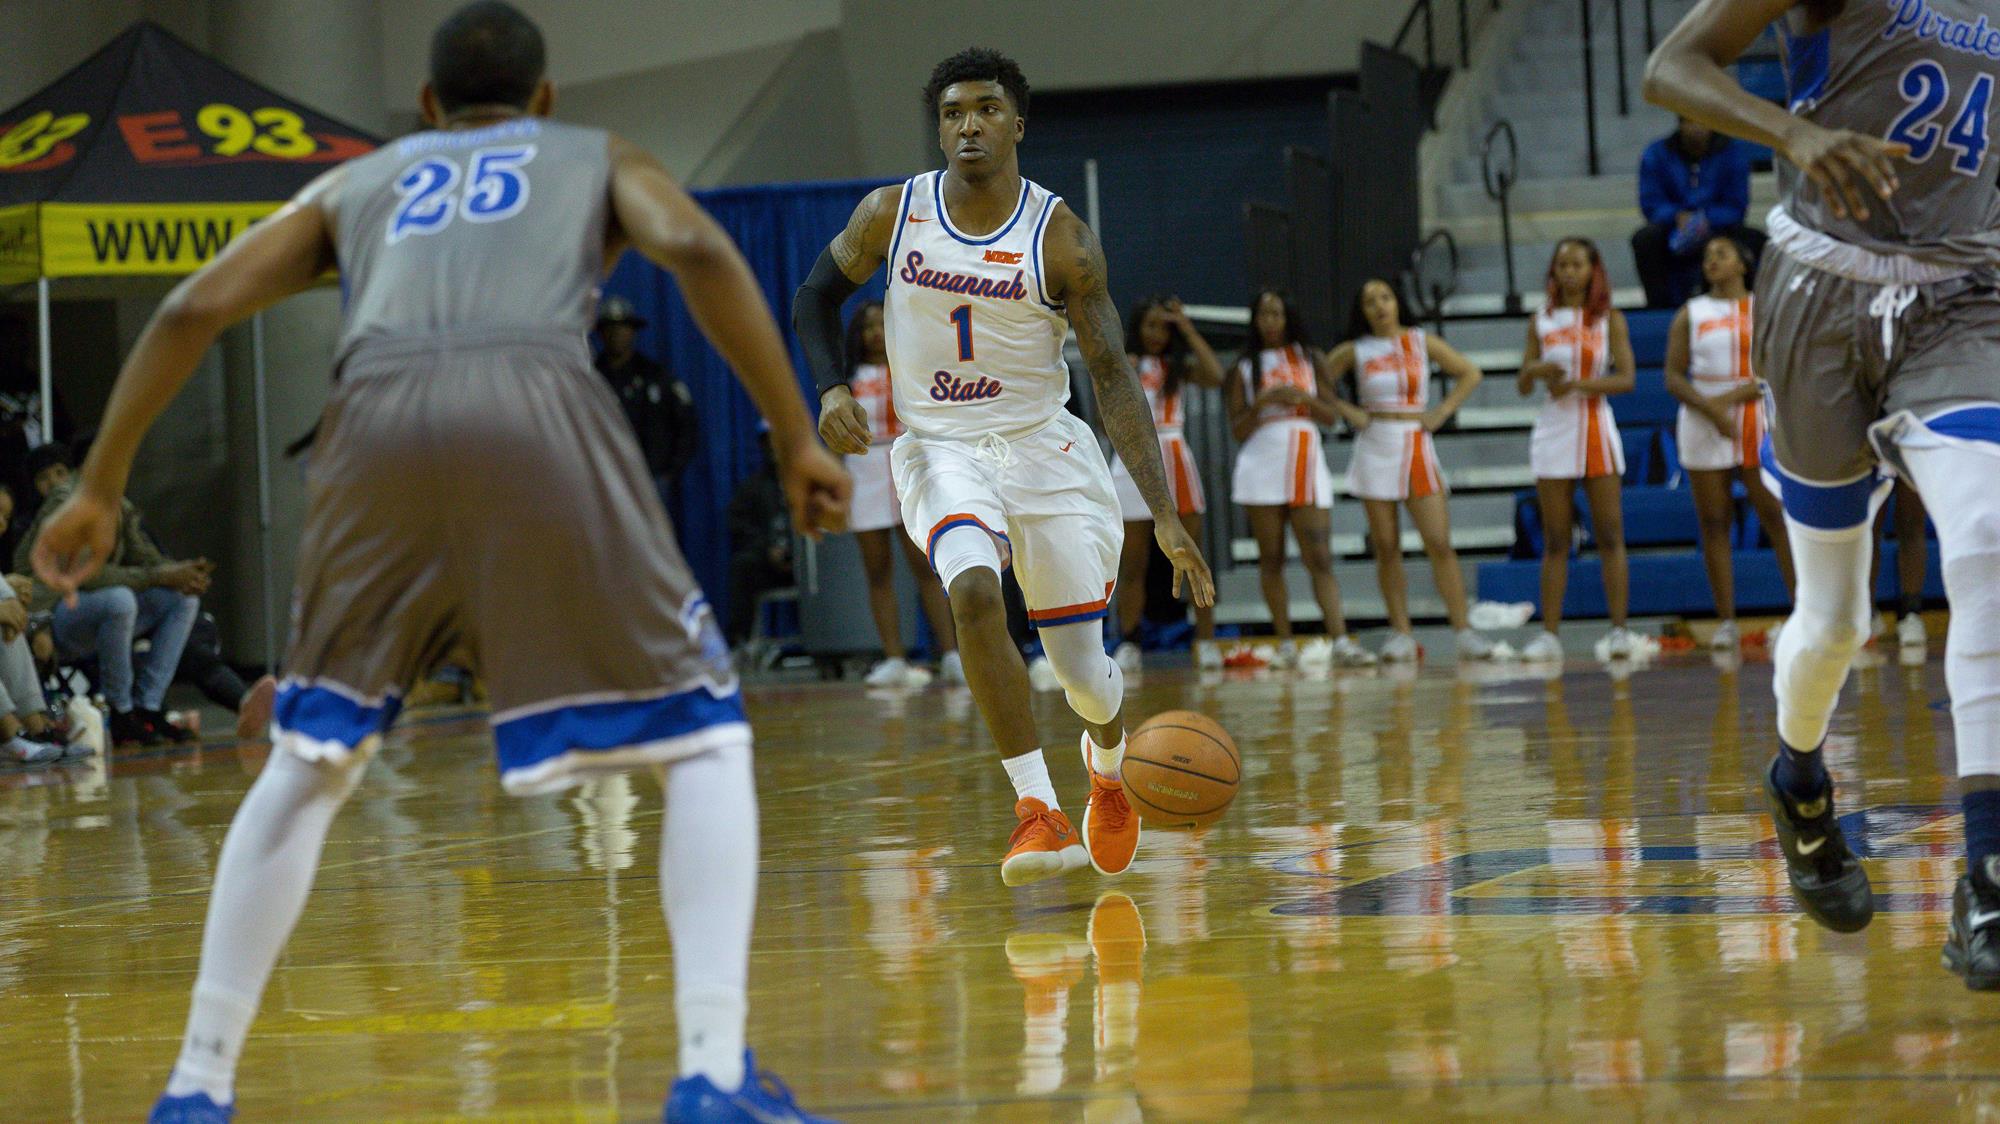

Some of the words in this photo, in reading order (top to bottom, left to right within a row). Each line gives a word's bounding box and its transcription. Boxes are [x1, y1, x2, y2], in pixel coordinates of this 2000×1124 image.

[1884, 58, 1994, 177] 24
[385, 144, 538, 245] 25
[900, 251, 1027, 300] Savannah
[950, 304, 974, 362] 1
[930, 371, 1002, 401] State
